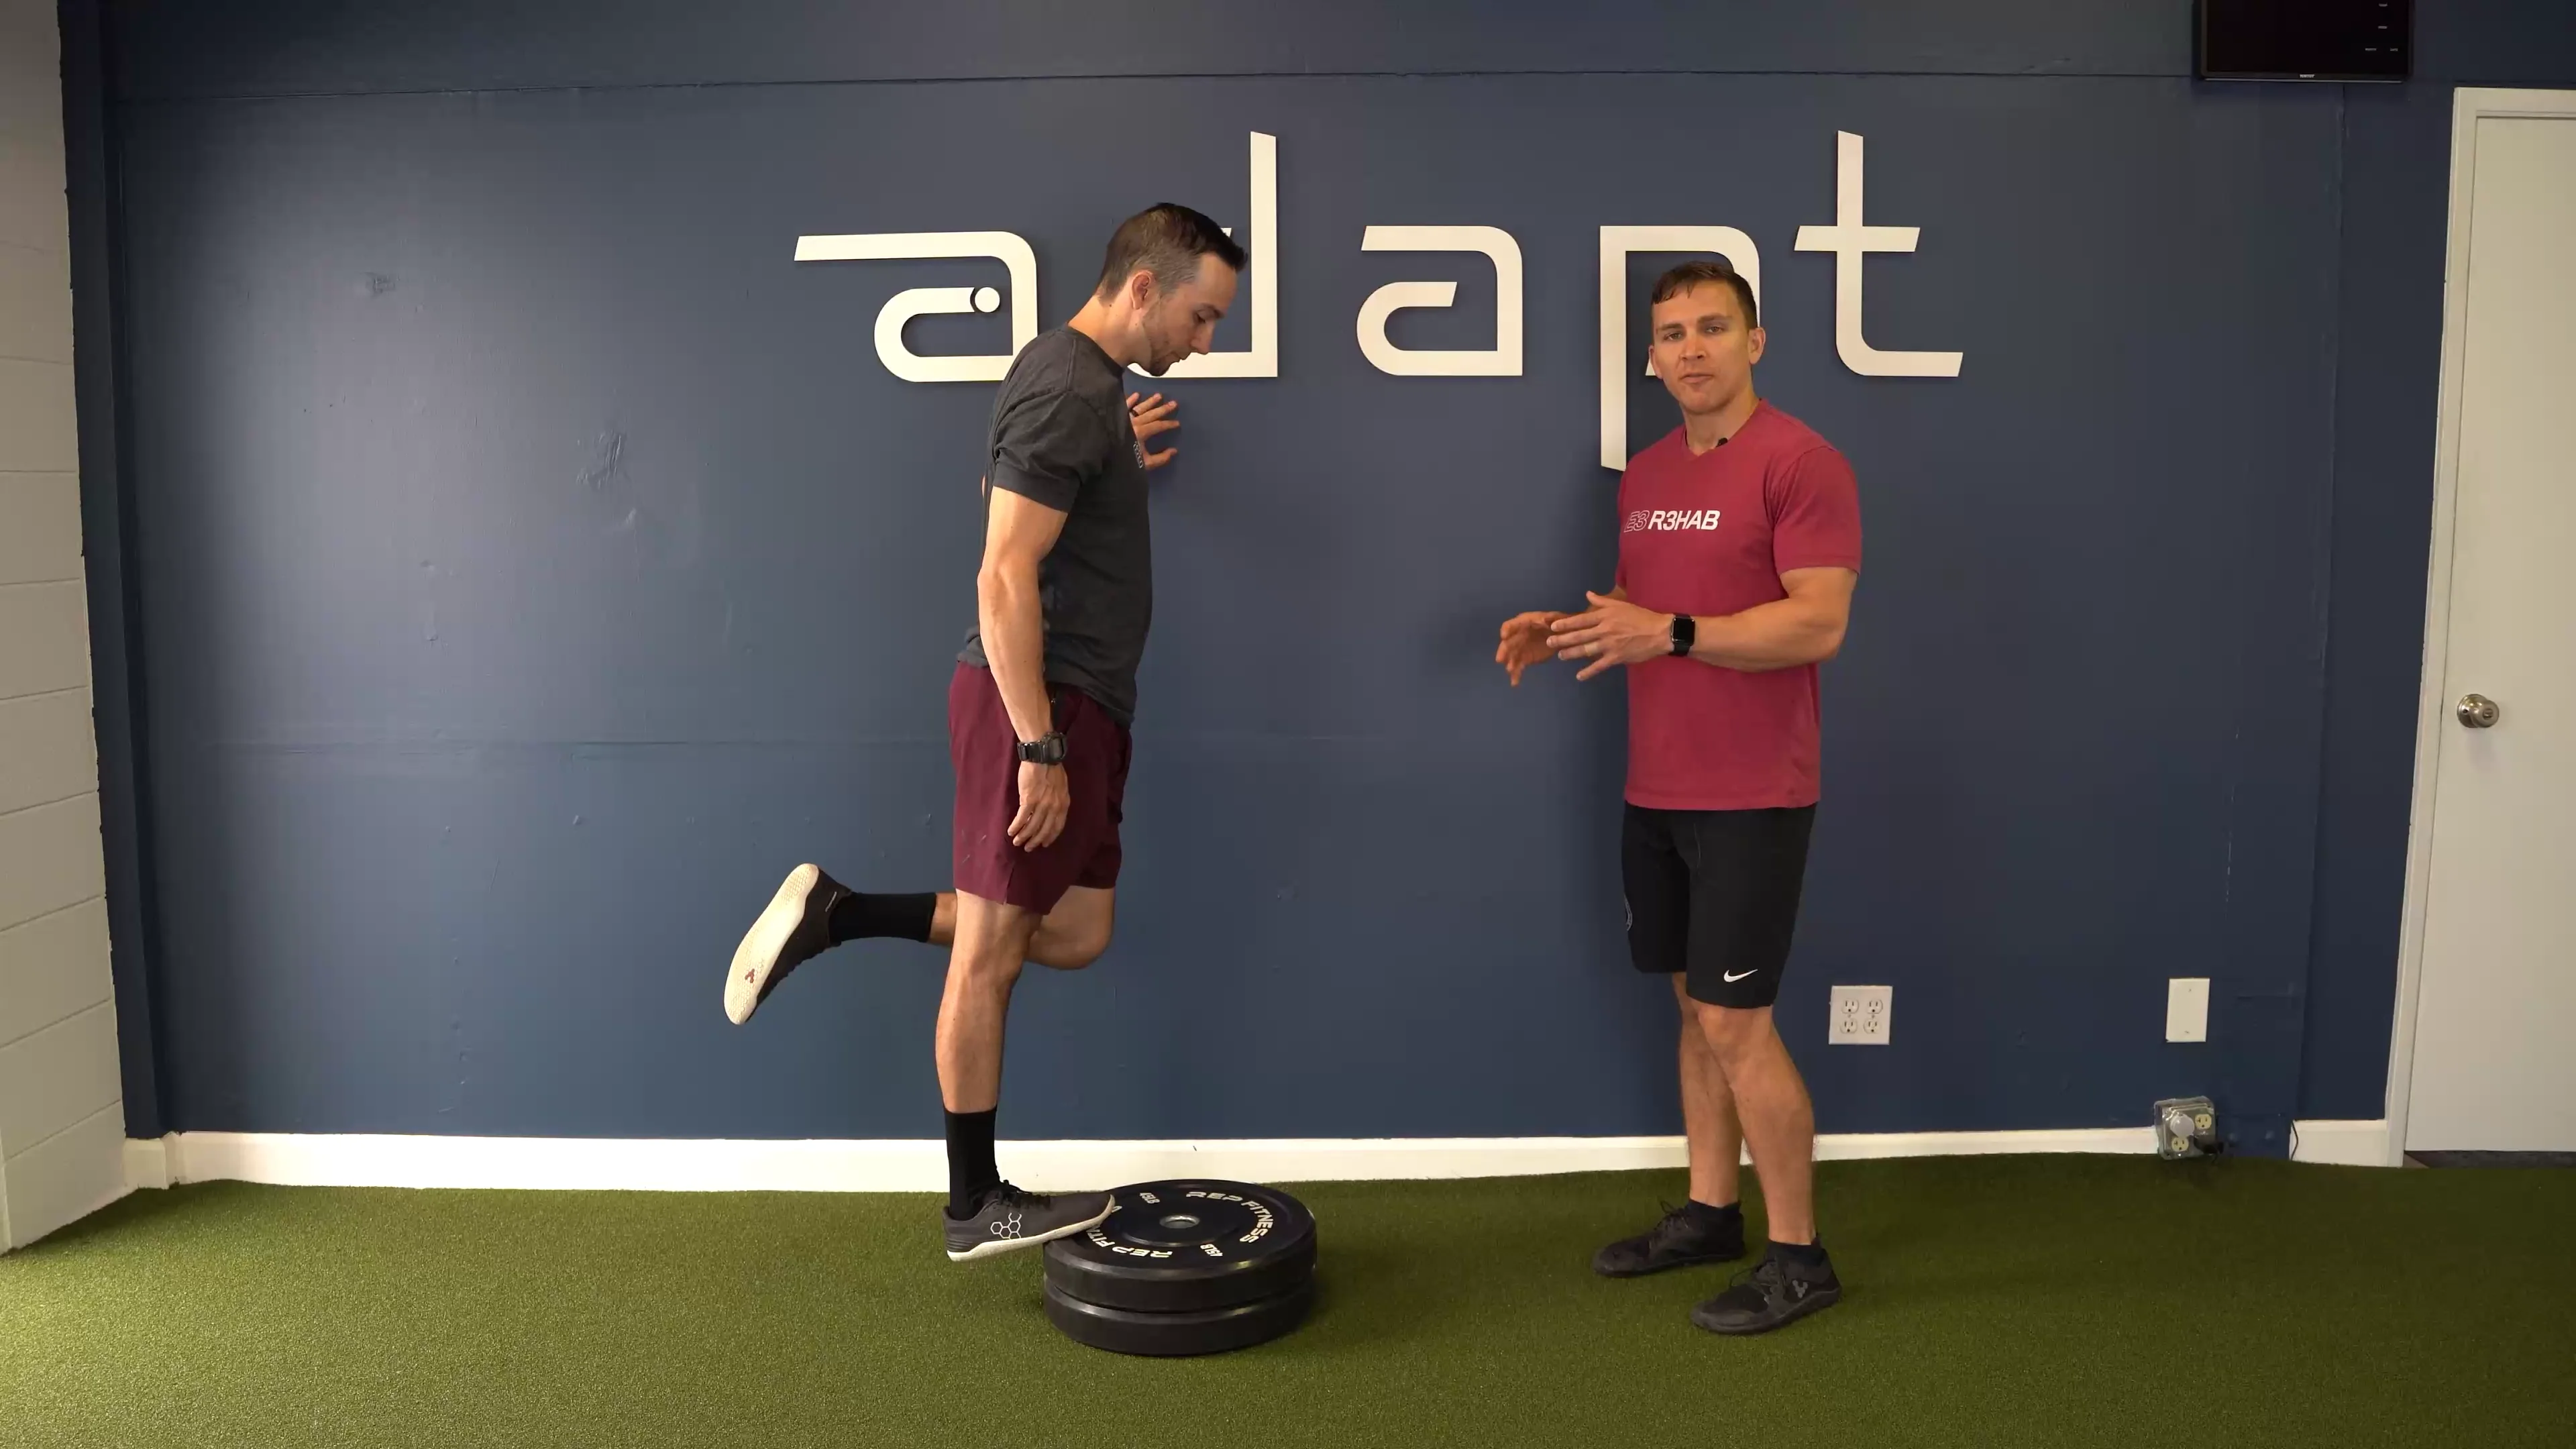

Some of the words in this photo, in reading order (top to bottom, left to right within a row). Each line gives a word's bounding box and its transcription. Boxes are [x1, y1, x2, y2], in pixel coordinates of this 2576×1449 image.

[1648, 510, 1721, 531] R3HAB
[1185, 1191, 1243, 1201] REP
[1239, 1201, 1274, 1243] FITNESS
[1112, 1246, 1173, 1258] REP
